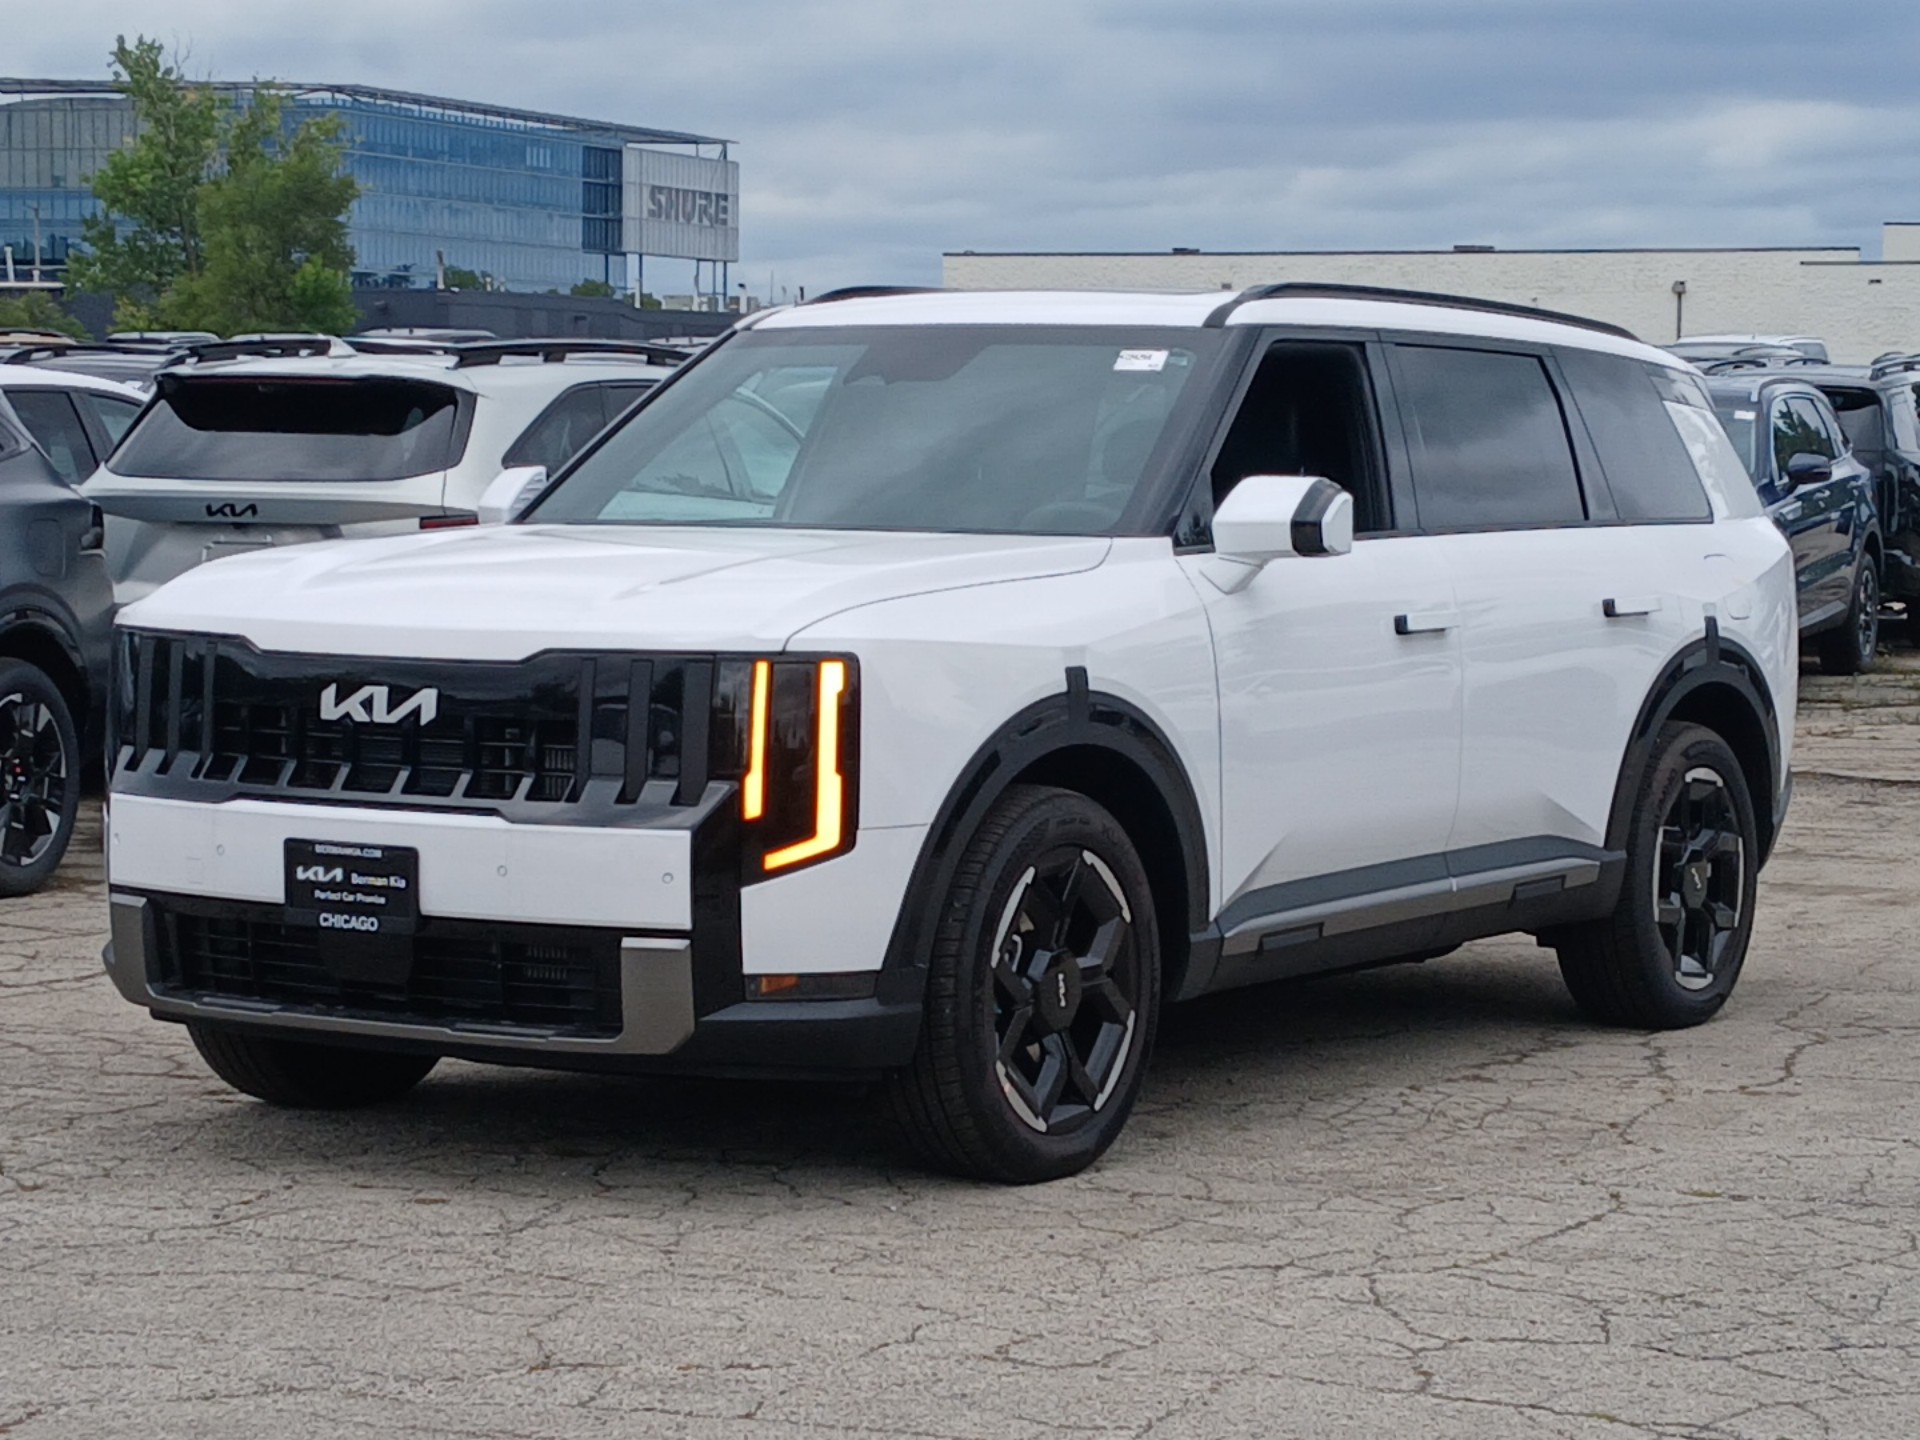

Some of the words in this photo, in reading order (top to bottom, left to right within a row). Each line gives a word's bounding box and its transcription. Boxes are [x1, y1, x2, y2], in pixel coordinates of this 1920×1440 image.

[647, 185, 729, 228] SHURE
[206, 503, 258, 518] KIA
[320, 682, 438, 726] KIA
[296, 865, 344, 883] KIA
[319, 912, 378, 931] CHICAGO
